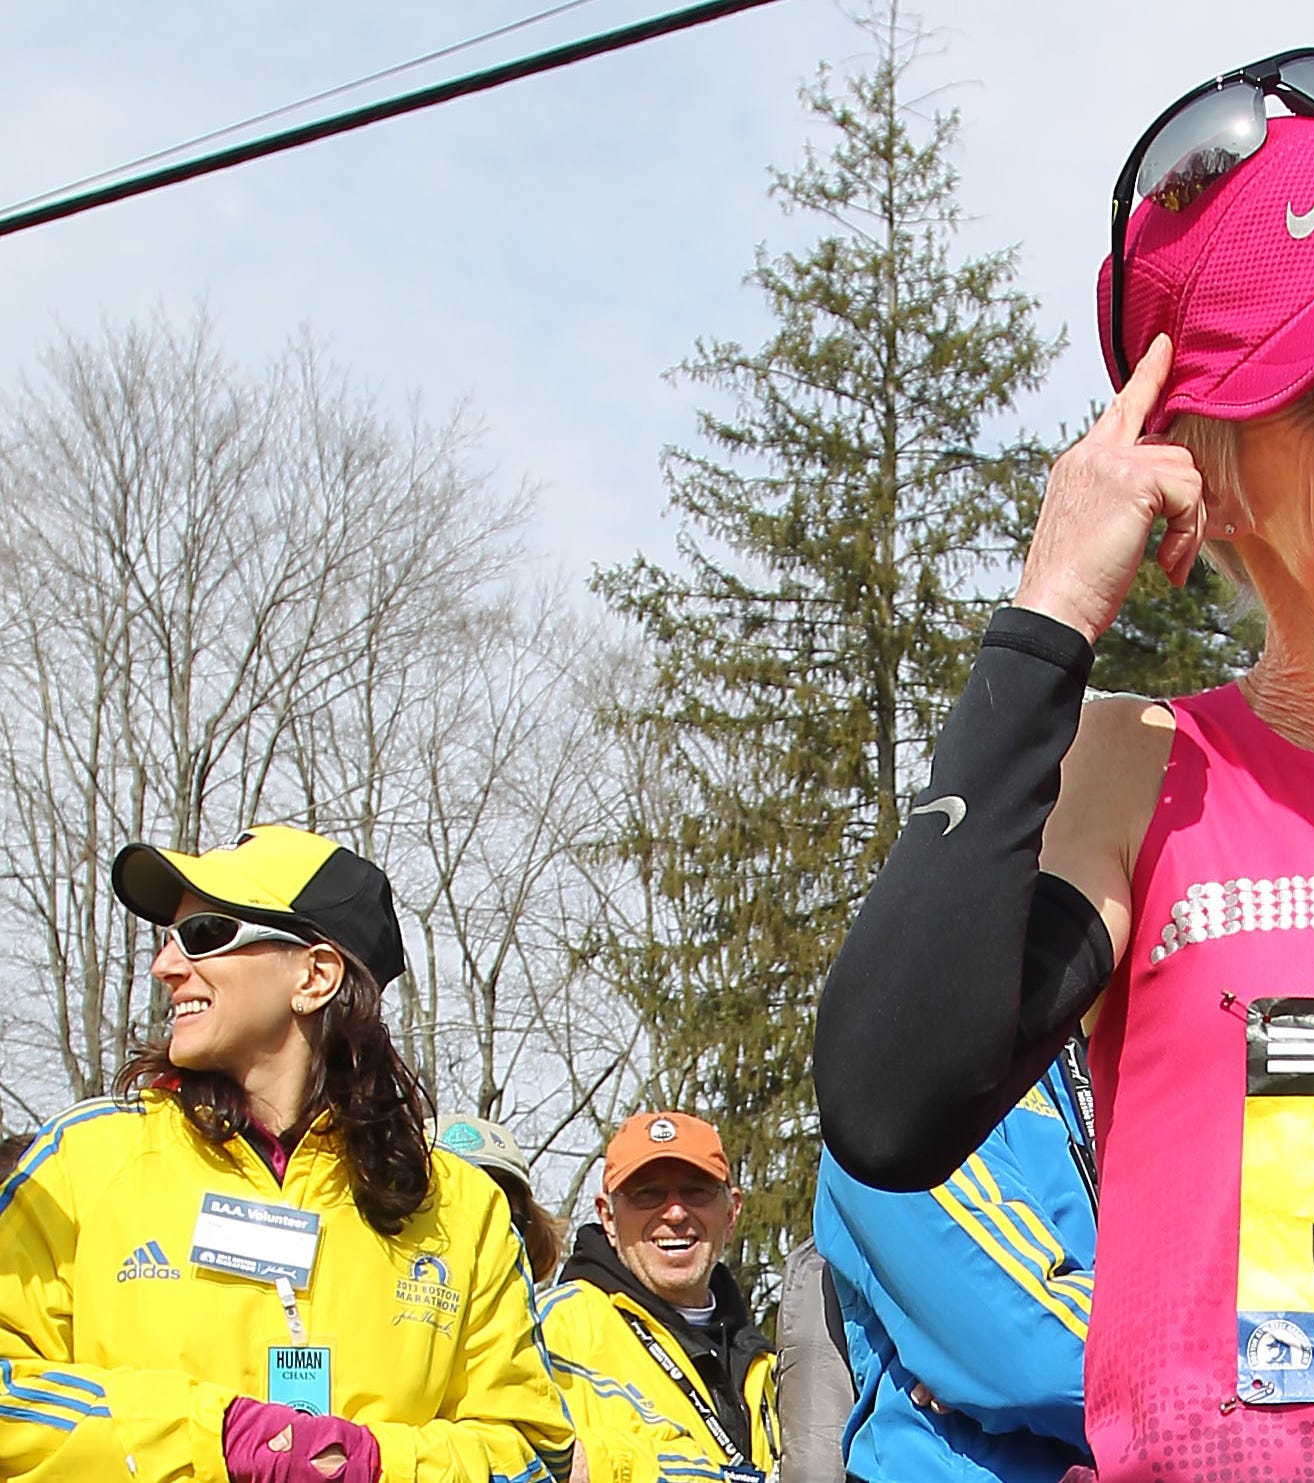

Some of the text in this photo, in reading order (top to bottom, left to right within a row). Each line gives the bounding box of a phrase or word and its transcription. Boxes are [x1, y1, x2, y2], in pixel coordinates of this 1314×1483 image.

[247, 1208, 309, 1229] Volunteer
[117, 1263, 181, 1283] adidas
[396, 1290, 458, 1313] MARATHON
[422, 1286, 460, 1302] BOSTON
[277, 1350, 322, 1369] HUMAN
[282, 1371, 316, 1380] CHAIN
